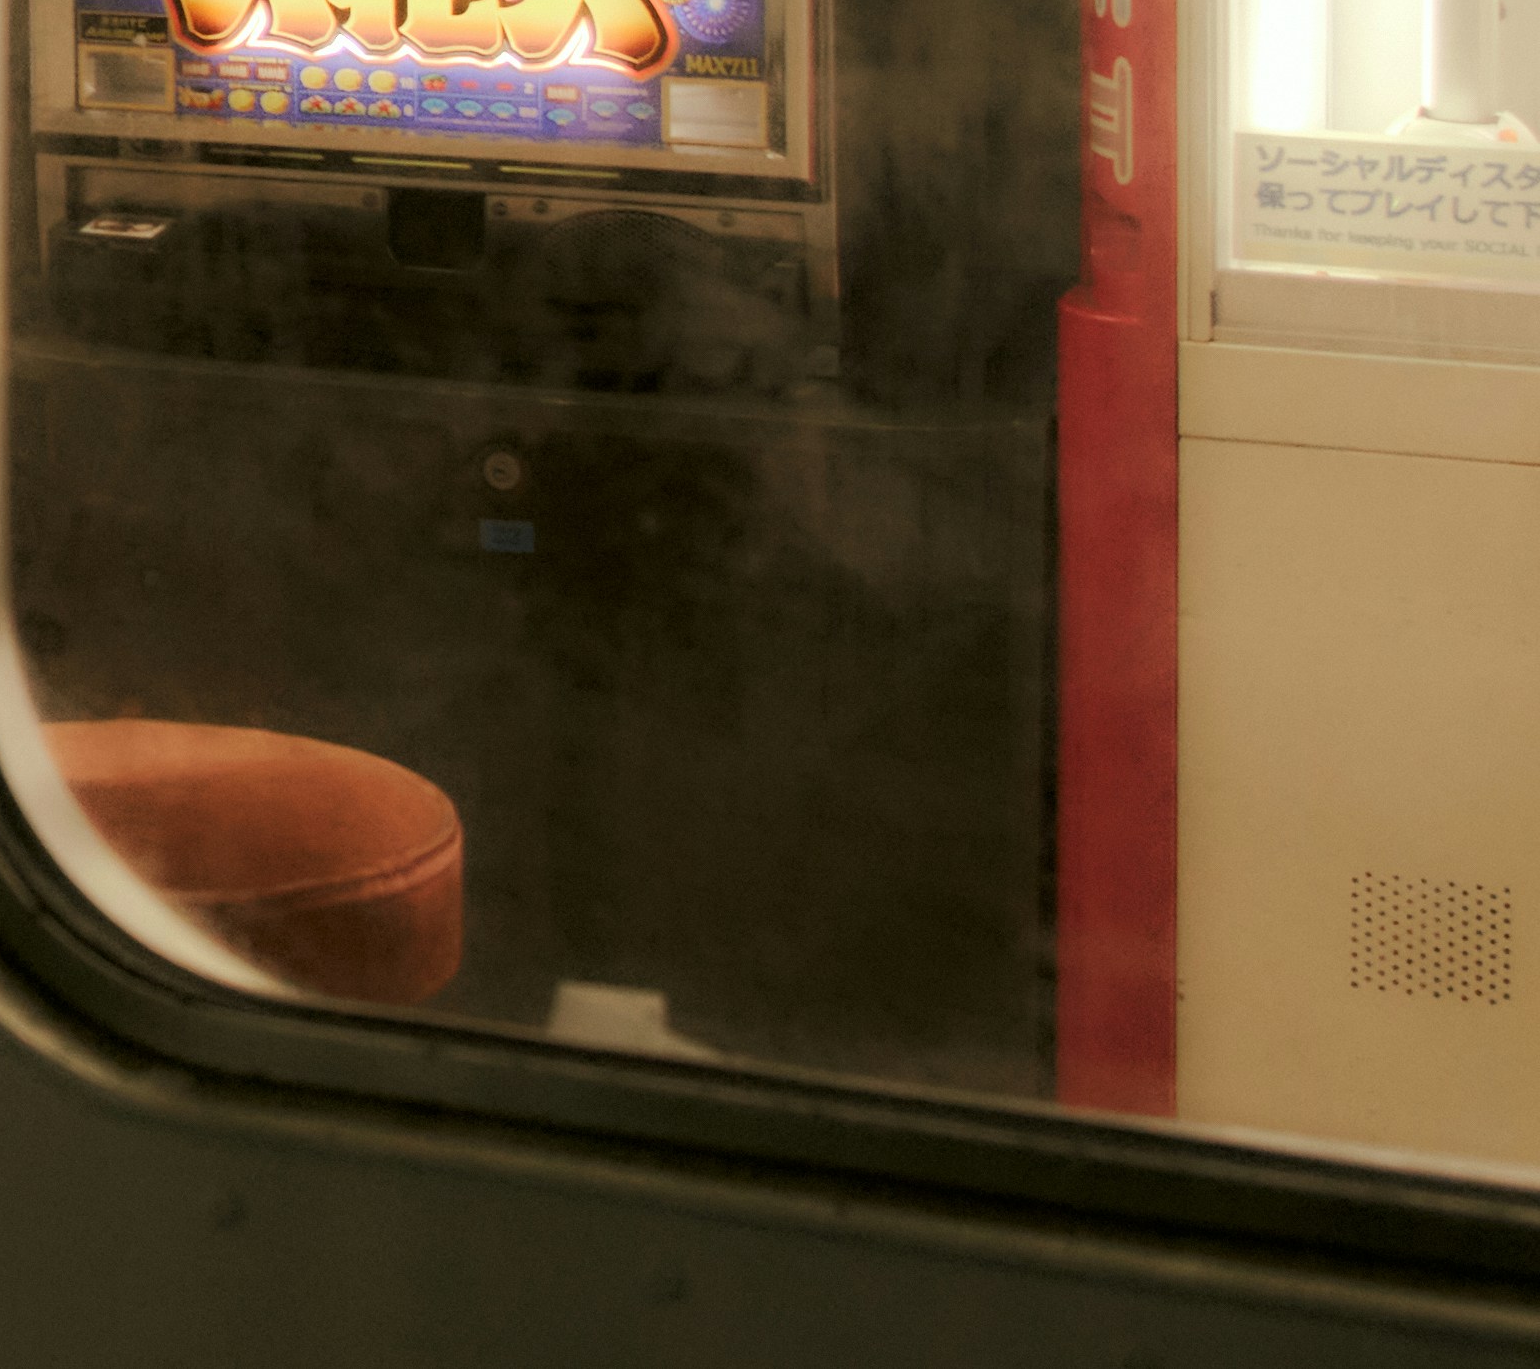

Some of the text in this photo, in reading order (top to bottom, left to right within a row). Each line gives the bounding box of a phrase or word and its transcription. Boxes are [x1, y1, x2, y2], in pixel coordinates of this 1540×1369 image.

[1253, 222, 1313, 241] Thanks
[1318, 228, 1343, 242] for
[1465, 237, 1529, 257] SOCIAL
